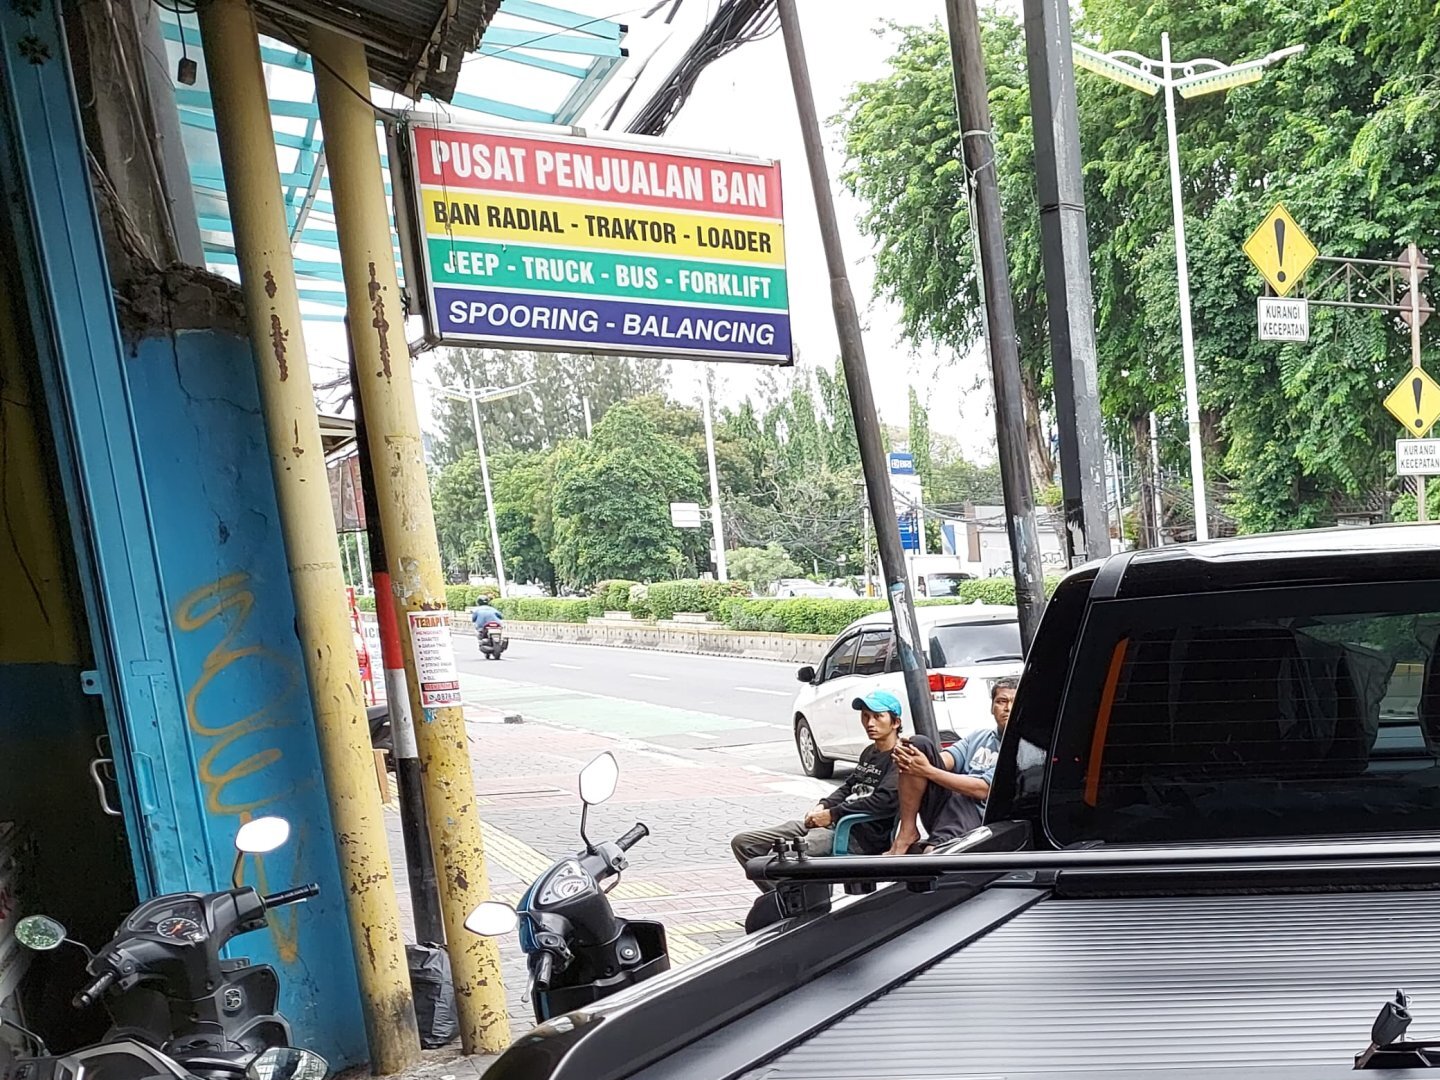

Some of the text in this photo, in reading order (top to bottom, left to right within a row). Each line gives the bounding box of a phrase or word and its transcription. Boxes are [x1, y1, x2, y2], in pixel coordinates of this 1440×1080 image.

[430, 139, 766, 209] PUSAT PENJUALAN BAN
[434, 200, 481, 227] BAN
[487, 205, 565, 235] RADIAL
[585, 214, 677, 245] TRAKTOR
[696, 226, 772, 254] LOADER
[443, 250, 500, 277] JEEP
[521, 256, 595, 285] TRUCK
[615, 264, 659, 290] BUS
[679, 270, 772, 300] FORKLIFT
[1265, 304, 1301, 321] KURANGI
[448, 300, 600, 333] SPOORING
[622, 313, 775, 346] BALANCING
[1262, 321, 1305, 337] KECEPATAN
[1403, 445, 1436, 456] KURANGI
[1400, 458, 1440, 468] KECEPATAN
[415, 617, 443, 628] TERAPI
